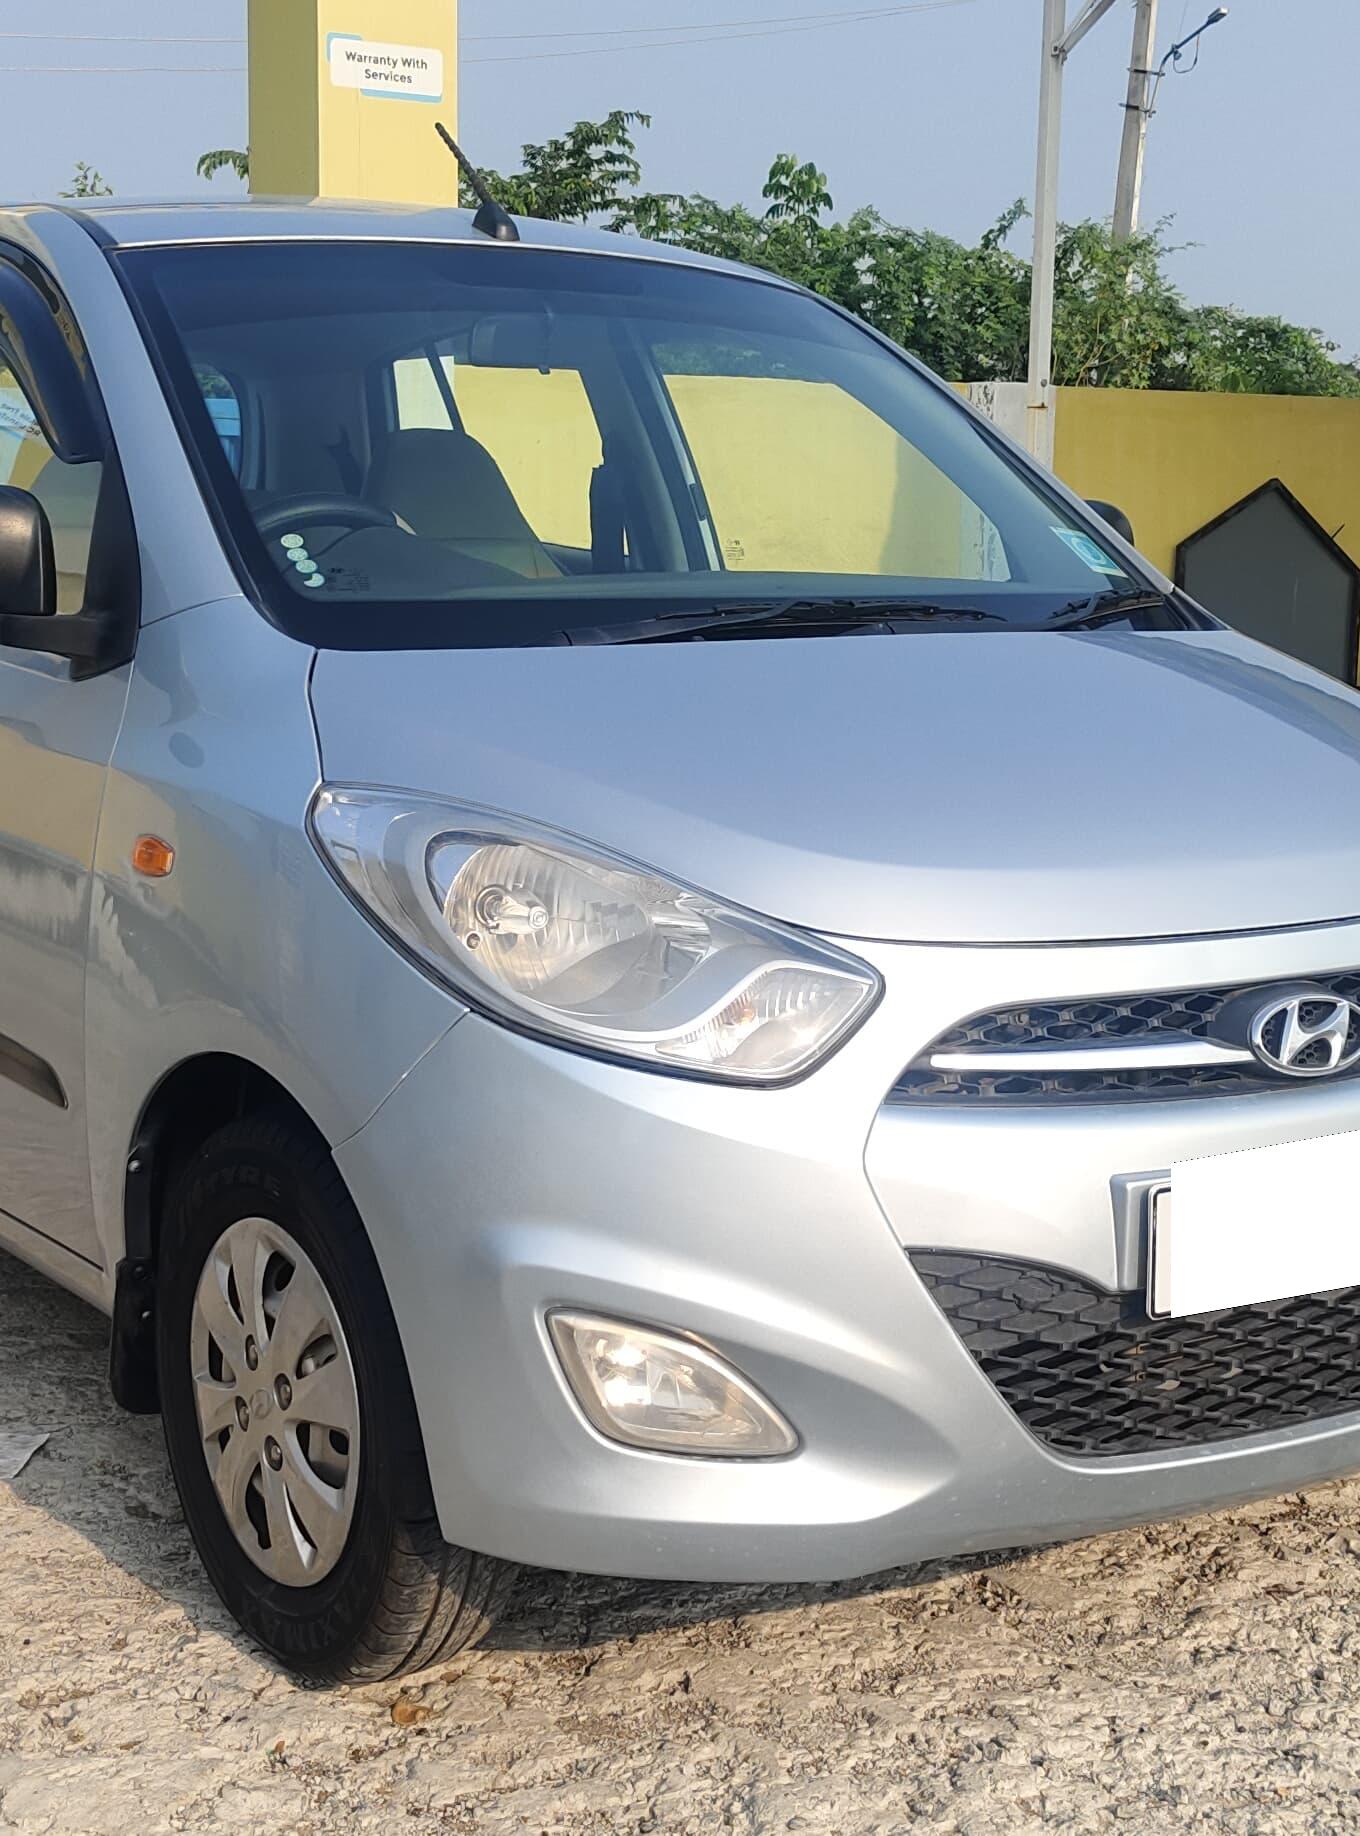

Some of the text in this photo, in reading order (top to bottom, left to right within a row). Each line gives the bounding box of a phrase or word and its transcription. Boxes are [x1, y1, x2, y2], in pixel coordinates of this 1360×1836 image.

[345, 50, 428, 70] Warranty With
[364, 68, 413, 84] Services
